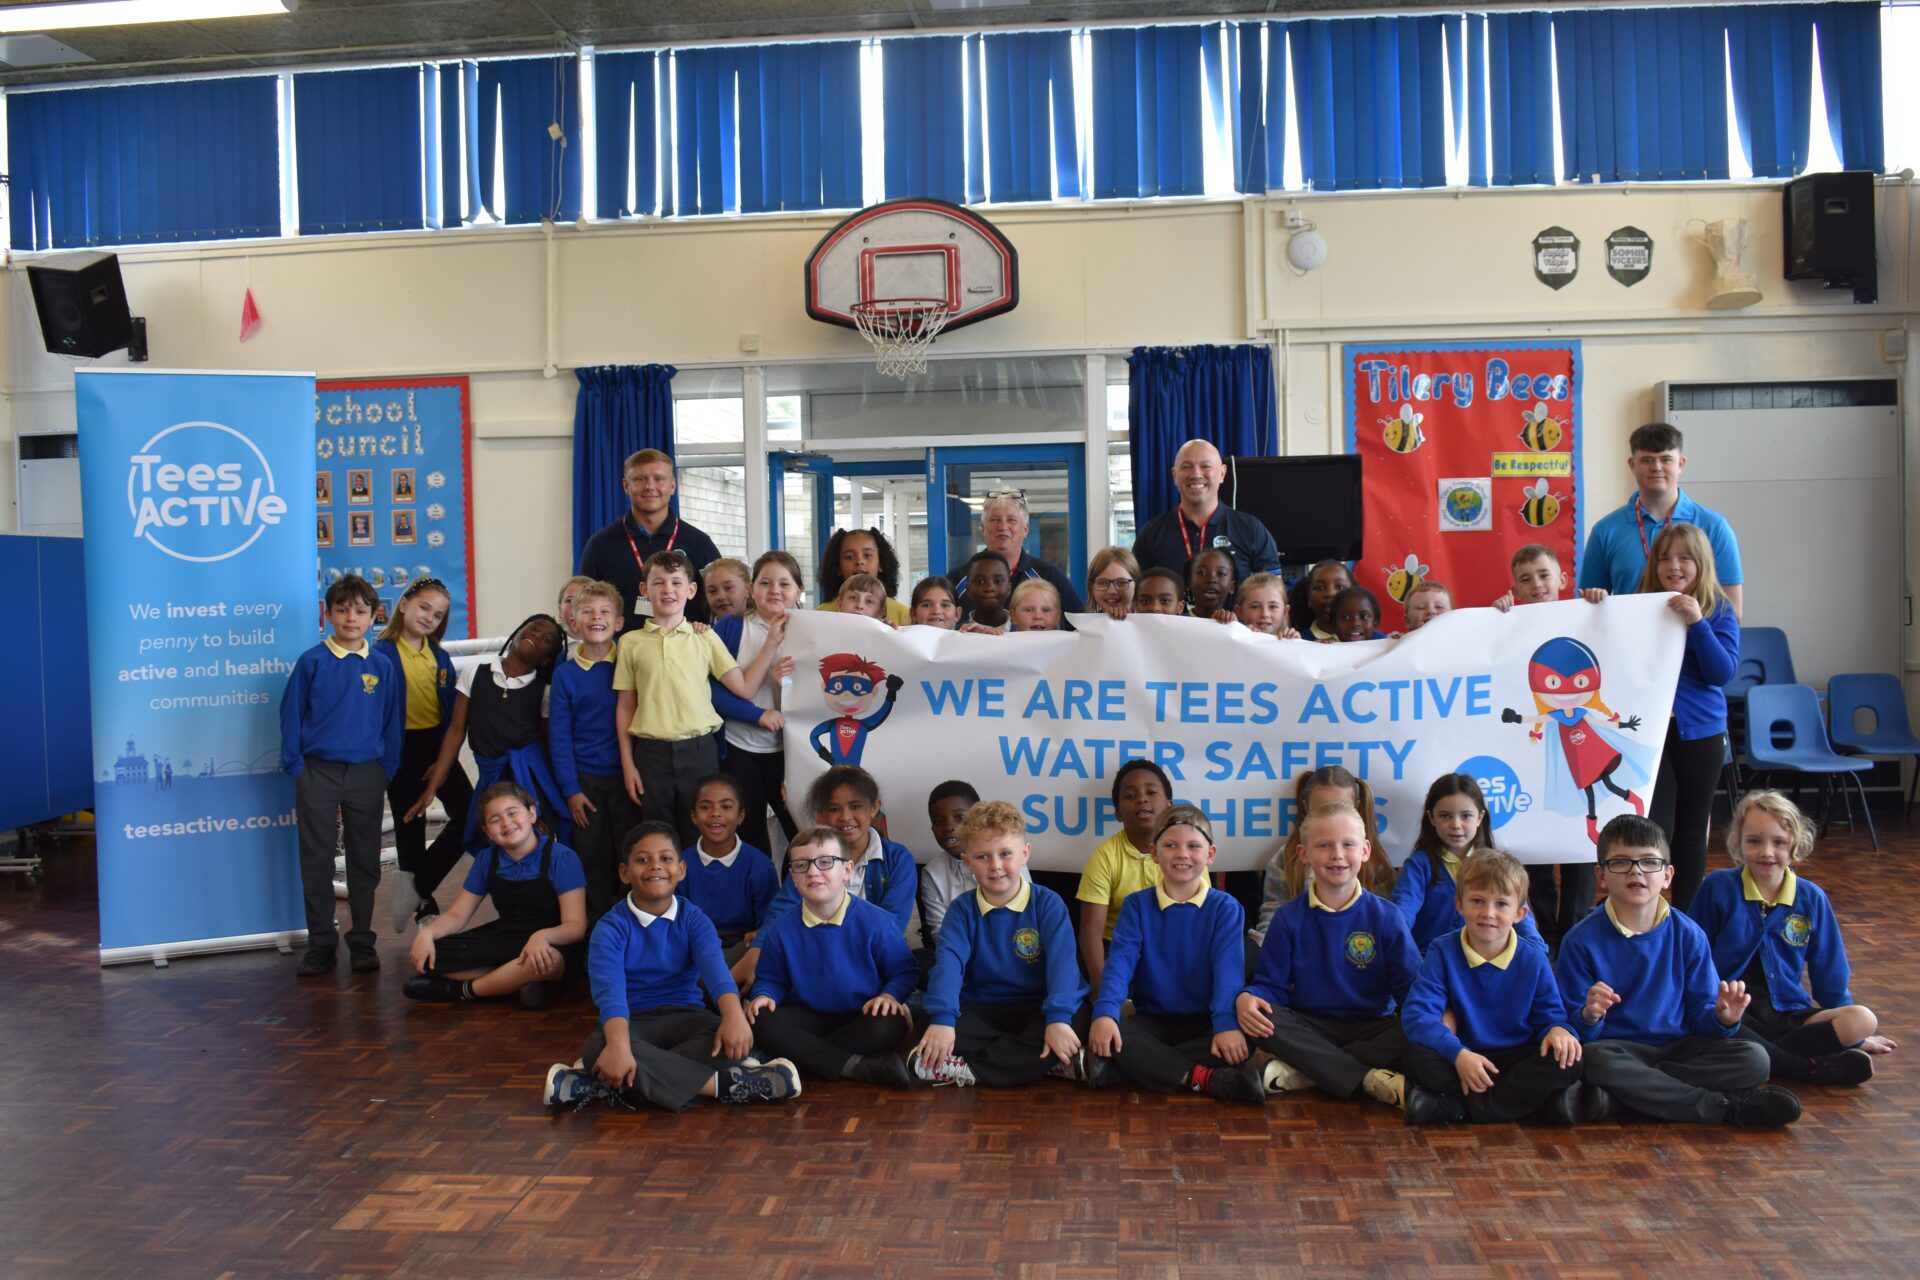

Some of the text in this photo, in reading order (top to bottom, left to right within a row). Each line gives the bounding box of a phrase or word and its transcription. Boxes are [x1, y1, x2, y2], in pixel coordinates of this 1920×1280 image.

[1612, 248, 1646, 257] SOPHIE
[1359, 358, 1569, 408] Tilery Bees
[317, 424, 424, 458] ouncil
[131, 455, 242, 492] Tees
[1494, 459, 1568, 472] Be Respectful
[129, 602, 283, 620] We invest every
[139, 628, 275, 655] penny to build
[118, 658, 297, 682] active and healthy
[150, 690, 269, 710] communities
[920, 675, 1492, 724] WE ARE TEES ACTIVE
[999, 736, 1417, 781] WATER SAFETY
[1022, 794, 1388, 837] SUPHERS
